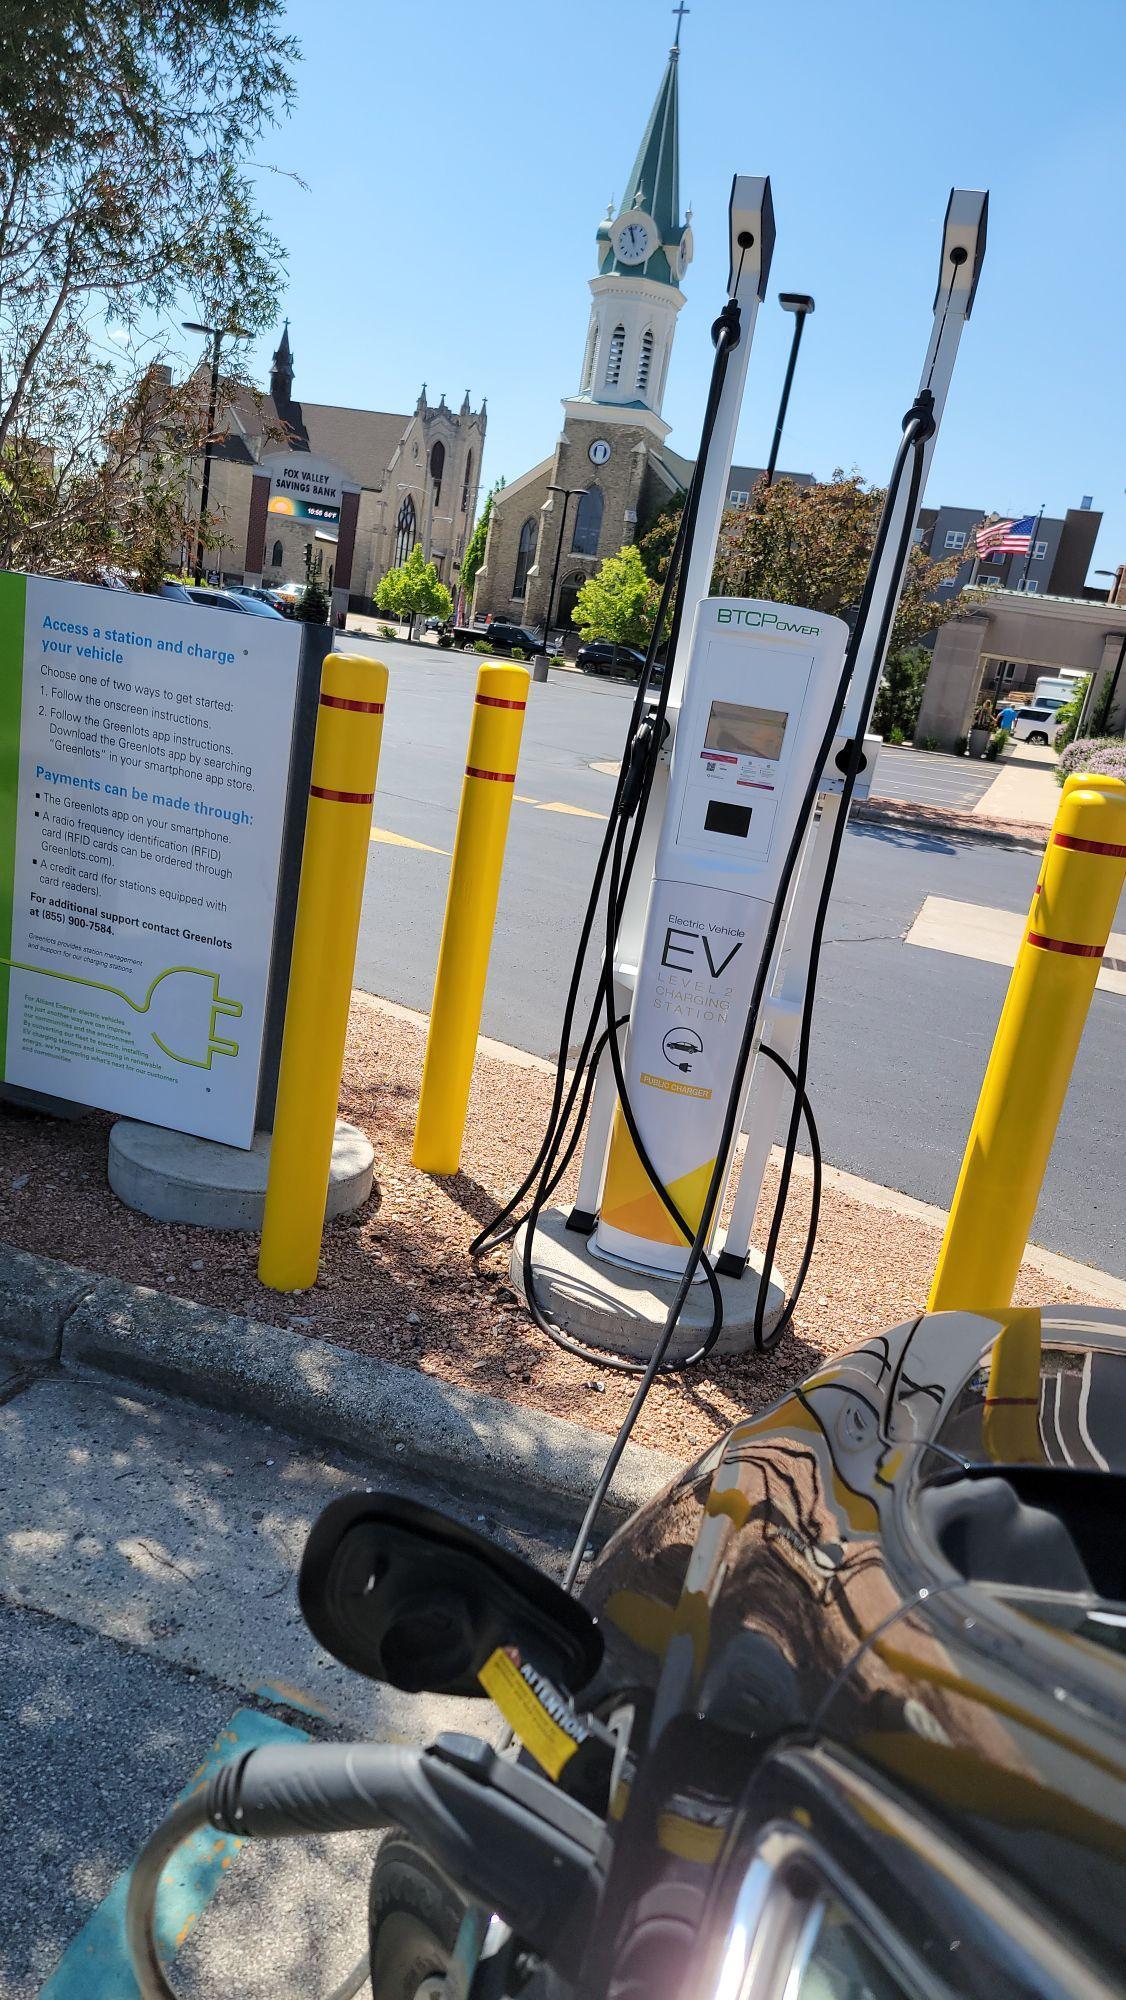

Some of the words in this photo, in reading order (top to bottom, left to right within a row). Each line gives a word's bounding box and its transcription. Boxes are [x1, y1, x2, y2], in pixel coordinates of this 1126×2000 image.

[276, 479, 310, 492] SAVINGS
[313, 486, 336, 497] BANK
[284, 469, 299, 479] FOX
[302, 472, 329, 484] VALLEY
[42, 615, 88, 636] Access
[92, 628, 100, 638] a
[104, 629, 152, 648] station
[156, 640, 183, 654] and
[187, 643, 235, 665] charge
[42, 639, 72, 654] your
[76, 645, 123, 664] vehicle
[40, 664, 76, 681] Choose
[79, 674, 98, 686] one
[99, 677, 110, 687] of
[113, 680, 132, 692] two
[134, 685, 160, 698] ways
[163, 690, 174, 700] to
[176, 693, 193, 704] get
[195, 697, 234, 712] started:
[41, 685, 48, 696] 1.
[51, 687, 83, 703] Follow
[85, 694, 101, 707] the
[103, 700, 148, 716] onscreen
[151, 710, 211, 729] instructions.
[38, 705, 47, 716] 2.
[50, 707, 82, 723] Follow
[84, 715, 100, 727] the
[102, 718, 150, 738] Greenlots
[152, 730, 171, 743] app
[173, 735, 233, 755] instructions.
[49, 723, 98, 743] Download
[100, 734, 116, 746] the
[118, 737, 166, 757] Greenlots
[168, 750, 187, 763] app
[189, 752, 201, 767] by
[203, 756, 252, 777] searching
[109, 753, 118, 762] in
[120, 754, 142, 767] your
[144, 760, 203, 780] smartphone
[205, 771, 224, 787] app
[226, 776, 254, 792] store.
[36, 765, 100, 792] Payments
[104, 784, 127, 797] can
[131, 786, 148, 802] be
[152, 794, 190, 811] made
[193, 801, 253, 825] through:
[42, 811, 50, 822] A
[52, 815, 75, 830] radio
[77, 818, 125, 841] frequency
[127, 829, 188, 854] identification
[190, 844, 221, 862] (RFID)
[43, 792, 61, 806] The
[63, 797, 109, 816] Greenlots
[111, 810, 129, 822] app
[131, 814, 144, 824] on
[146, 818, 168, 830] your
[170, 823, 231, 844] smartphone.
[41, 827, 62, 841] card
[64, 830, 90, 846] (RFID
[92, 840, 118, 853] cards
[120, 846, 138, 856] can
[140, 848, 152, 860] be
[154, 854, 193, 870] ordered
[195, 861, 232, 880] through
[41, 840, 114, 867] Greenlots.com).
[39, 875, 59, 887] card
[60, 880, 101, 897] readers).
[40, 859, 48, 870] A
[49, 863, 76, 876] credit
[78, 870, 98, 882] card
[100, 873, 117, 885] (for
[119, 879, 156, 895] stations
[159, 889, 204, 906] equipped
[205, 900, 227, 912] with
[29, 908, 40, 917] at
[42, 908, 65, 924] (855)
[68, 915, 114, 936] 900-7584.
[30, 891, 47, 904] For
[48, 898, 98, 917] additional
[100, 911, 140, 927] support
[142, 921, 180, 937] contact
[182, 929, 232, 950] Greenlots
[668, 914, 705, 930] Electric
[708, 923, 745, 938] Vehicle
[661, 928, 743, 978] EV
[656, 986, 730, 1010] CHARGING
[658, 972, 717, 994] LEVEL
[724, 988, 732, 996] 2
[654, 999, 728, 1023] STATION
[644, 1076, 670, 1088] PUBLIC
[671, 1084, 709, 1097] CHARGER
[520, 1663, 588, 1744] ATTENTION
